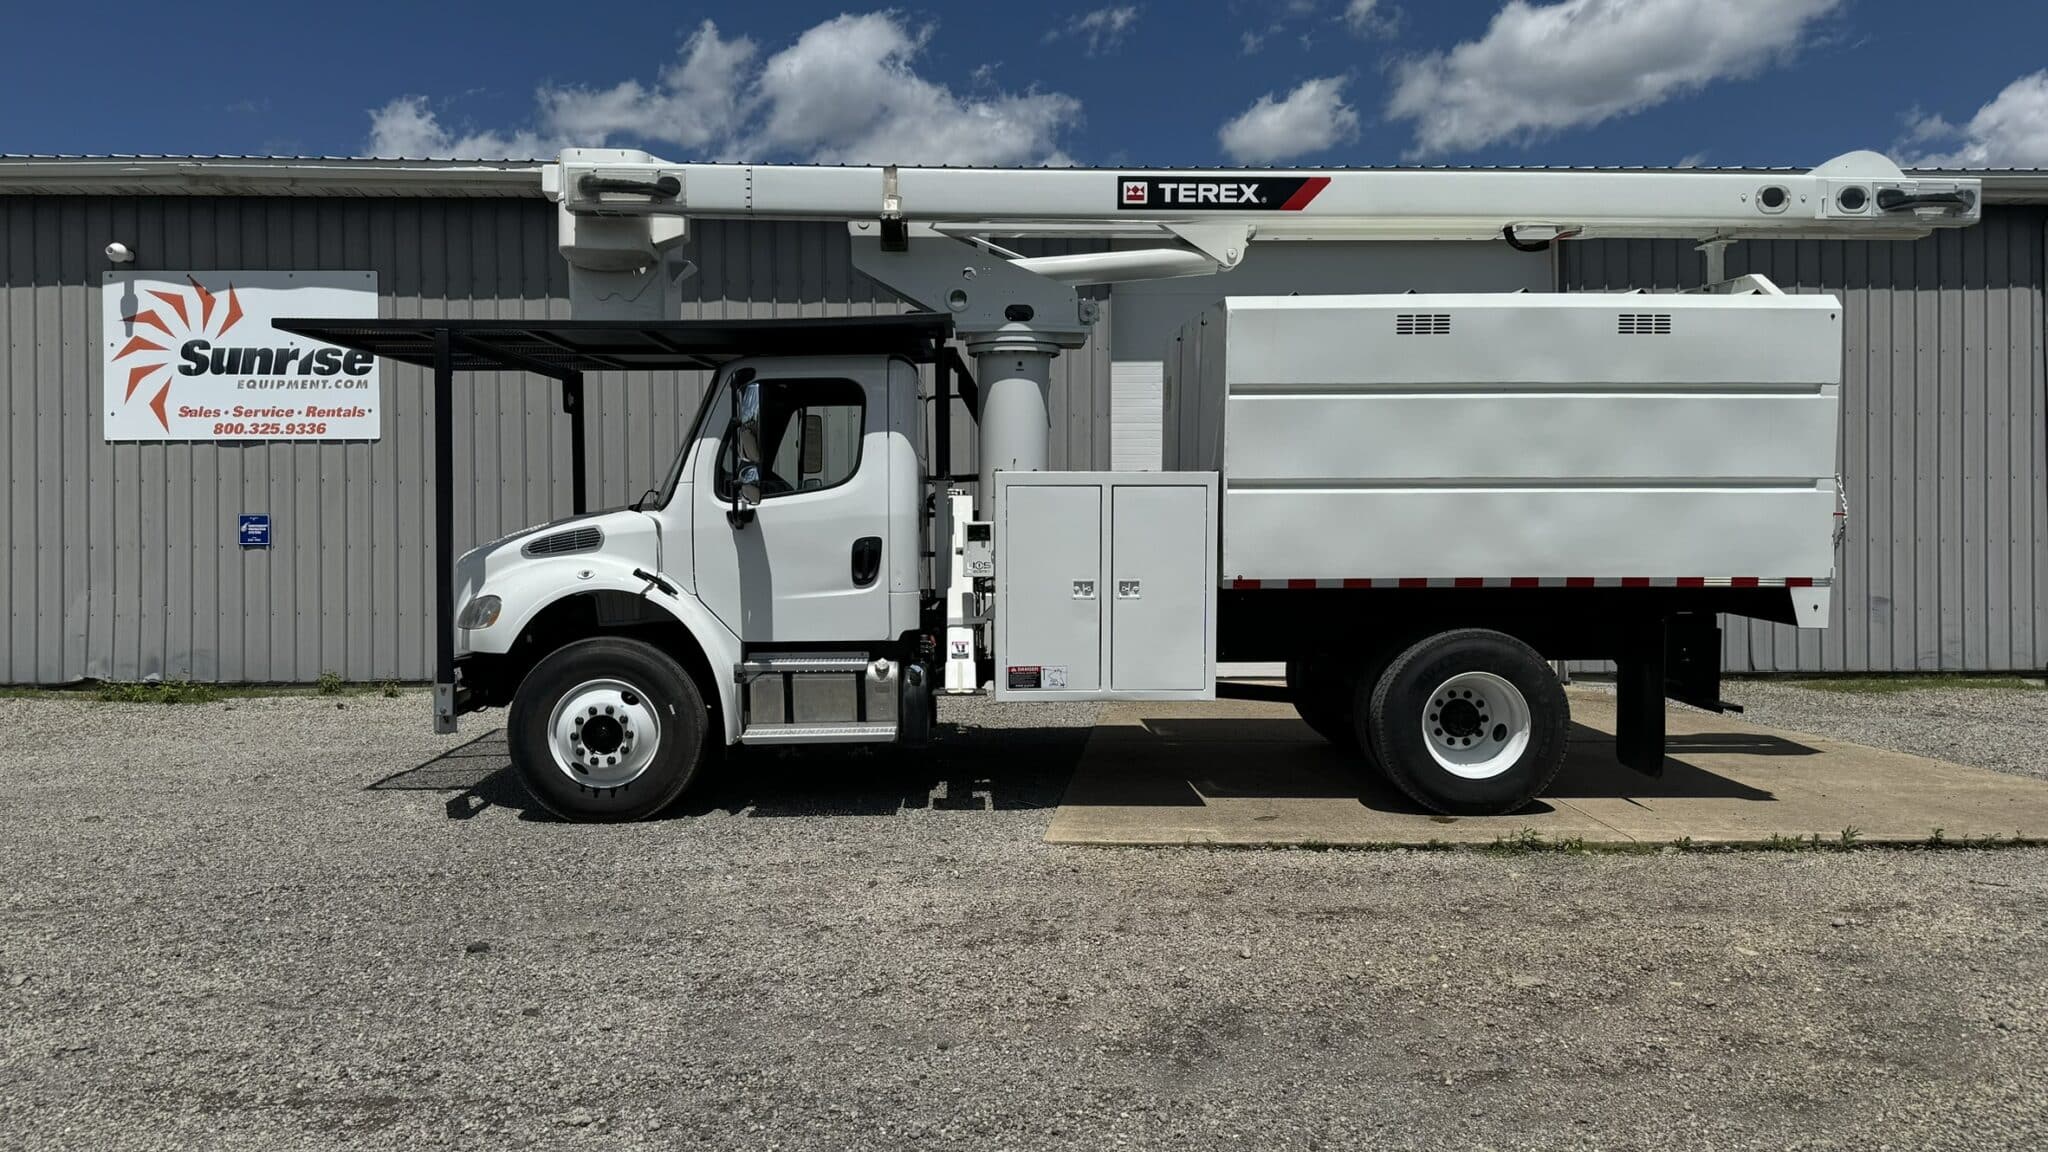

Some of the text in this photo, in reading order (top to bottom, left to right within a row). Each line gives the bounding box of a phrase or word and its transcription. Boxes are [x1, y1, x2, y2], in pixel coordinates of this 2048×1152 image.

[1158, 183, 1260, 203] TEREX
[177, 339, 375, 377] Sunrise
[236, 379, 369, 390] EQUIPMENT.COM
[178, 405, 366, 418] Sales Service Rentals
[213, 422, 327, 435] 800.325.9336
